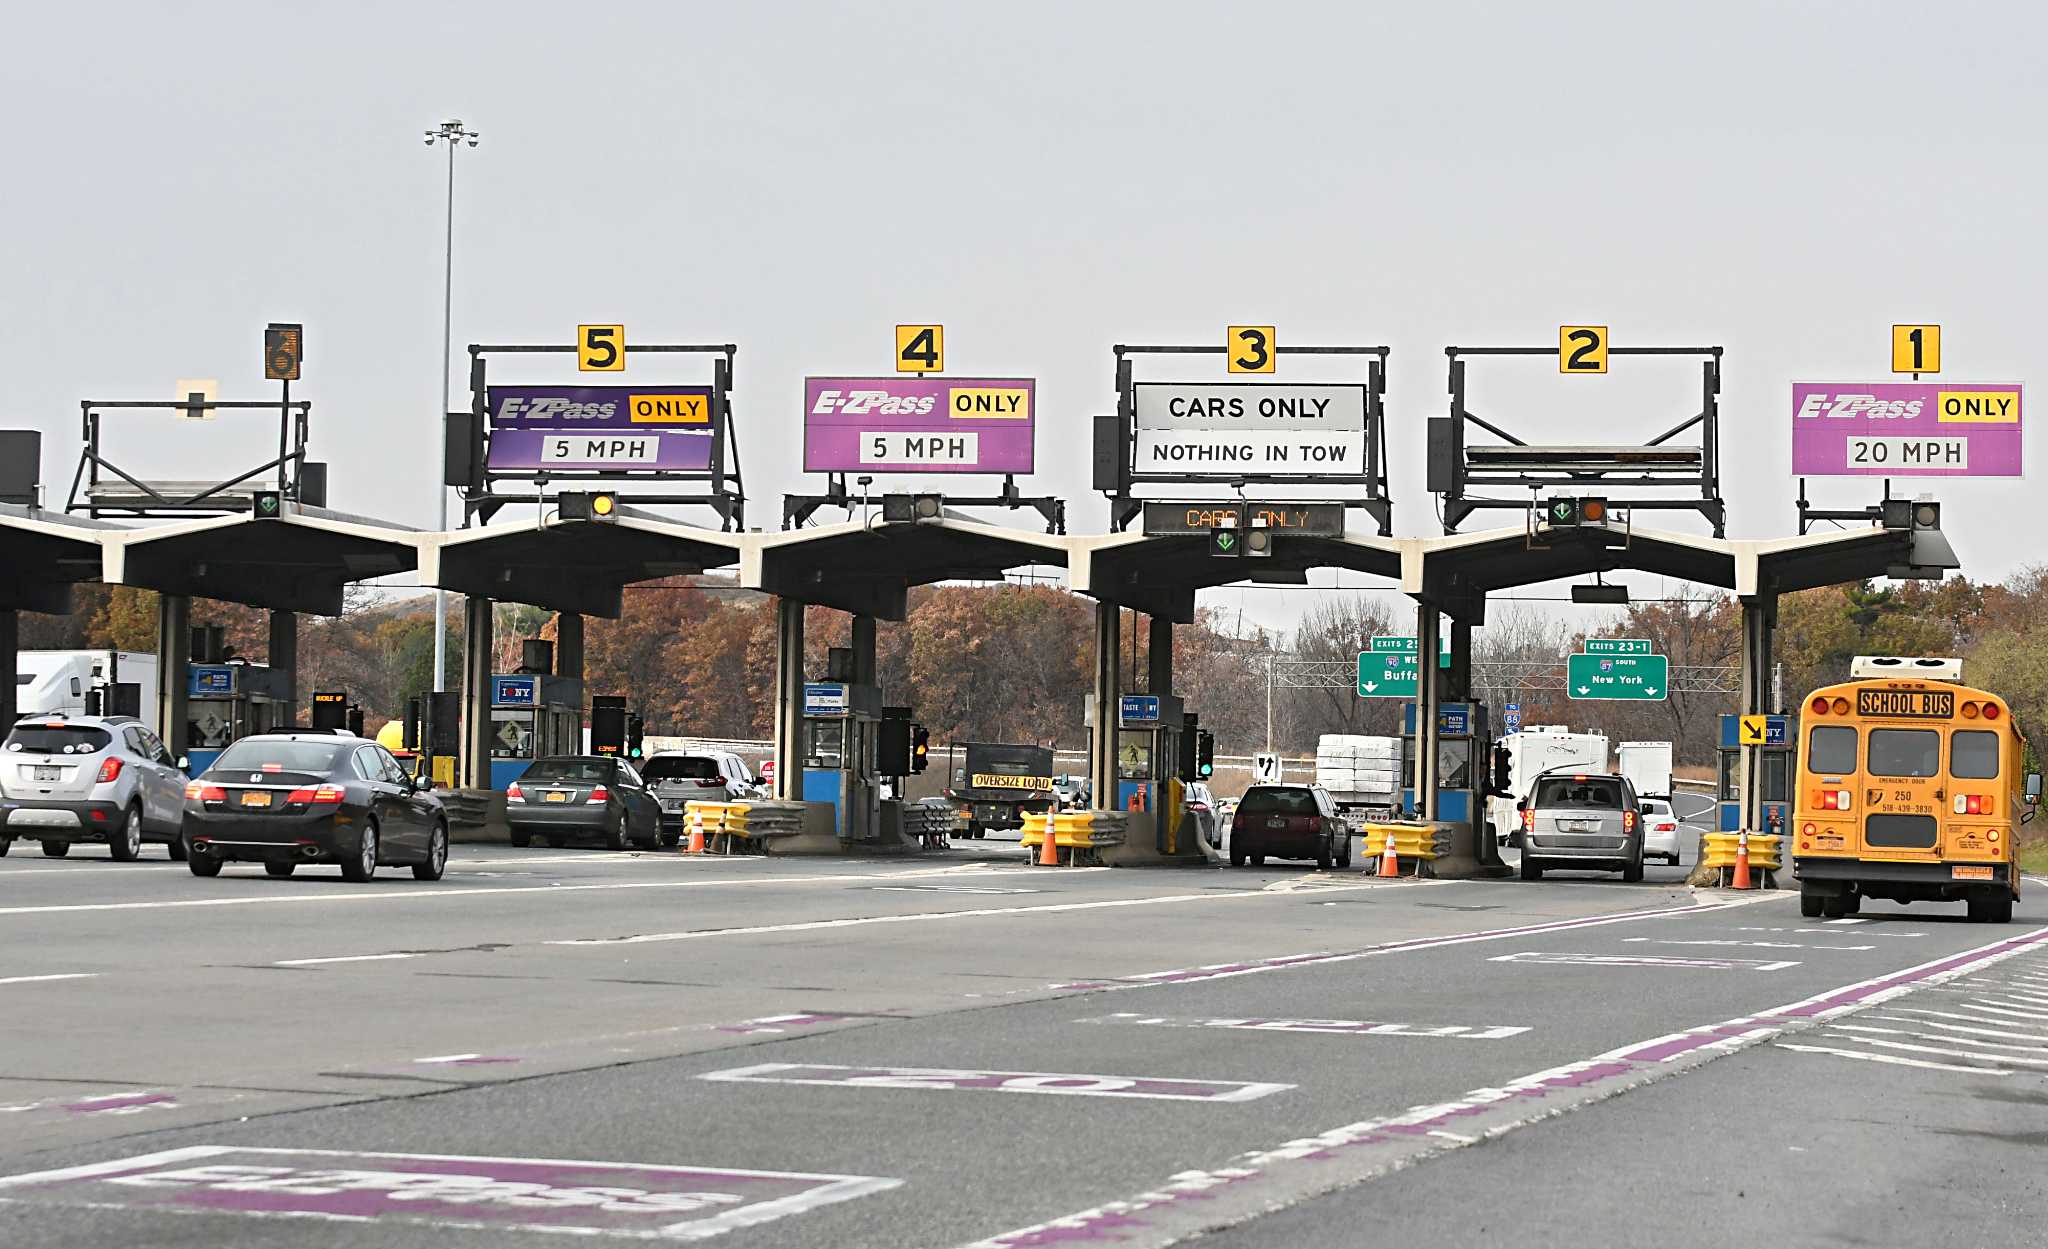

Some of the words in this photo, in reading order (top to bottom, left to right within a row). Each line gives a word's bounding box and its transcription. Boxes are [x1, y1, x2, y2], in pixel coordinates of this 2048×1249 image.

[269, 333, 294, 374] 6
[587, 329, 617, 367] 5
[901, 329, 939, 368] 4
[1237, 330, 1268, 369] 3
[1567, 330, 1600, 369] 2
[1909, 328, 1923, 369] 1
[497, 397, 616, 420] E-ZPass
[636, 400, 700, 417] ONLY
[811, 390, 936, 415] E-ZPass
[956, 394, 1021, 413] ONLY
[1169, 397, 1245, 418] CARS
[1258, 397, 1331, 418] ONLY
[1797, 393, 1924, 419] E-ZPass
[1945, 398, 2011, 416] ONLY
[555, 441, 569, 458] 5
[587, 441, 645, 458] MPH
[874, 437, 887, 458] 5
[905, 437, 965, 458] MPH
[1153, 444, 1253, 461] NOTHING
[1266, 445, 1288, 461] IN
[1299, 445, 1347, 462] TOW
[1854, 441, 1888, 463] 20
[1903, 442, 1961, 463] MPH
[1186, 509, 1238, 527] CARS
[1377, 640, 1402, 648] EXITS
[1589, 642, 1614, 650] EXITS
[1618, 642, 1647, 652] 23-1
[1404, 656, 1417, 664] WE
[1384, 670, 1418, 681] Buffa
[1592, 675, 1614, 684] New
[1619, 675, 1643, 684] York
[514, 688, 531, 697] NY
[1862, 693, 1917, 713] SCHOOL
[1922, 694, 1950, 715] BUS
[975, 775, 1020, 787] OVERSIZE
[1022, 777, 1049, 789] LOAD
[1895, 790, 1912, 801] 250
